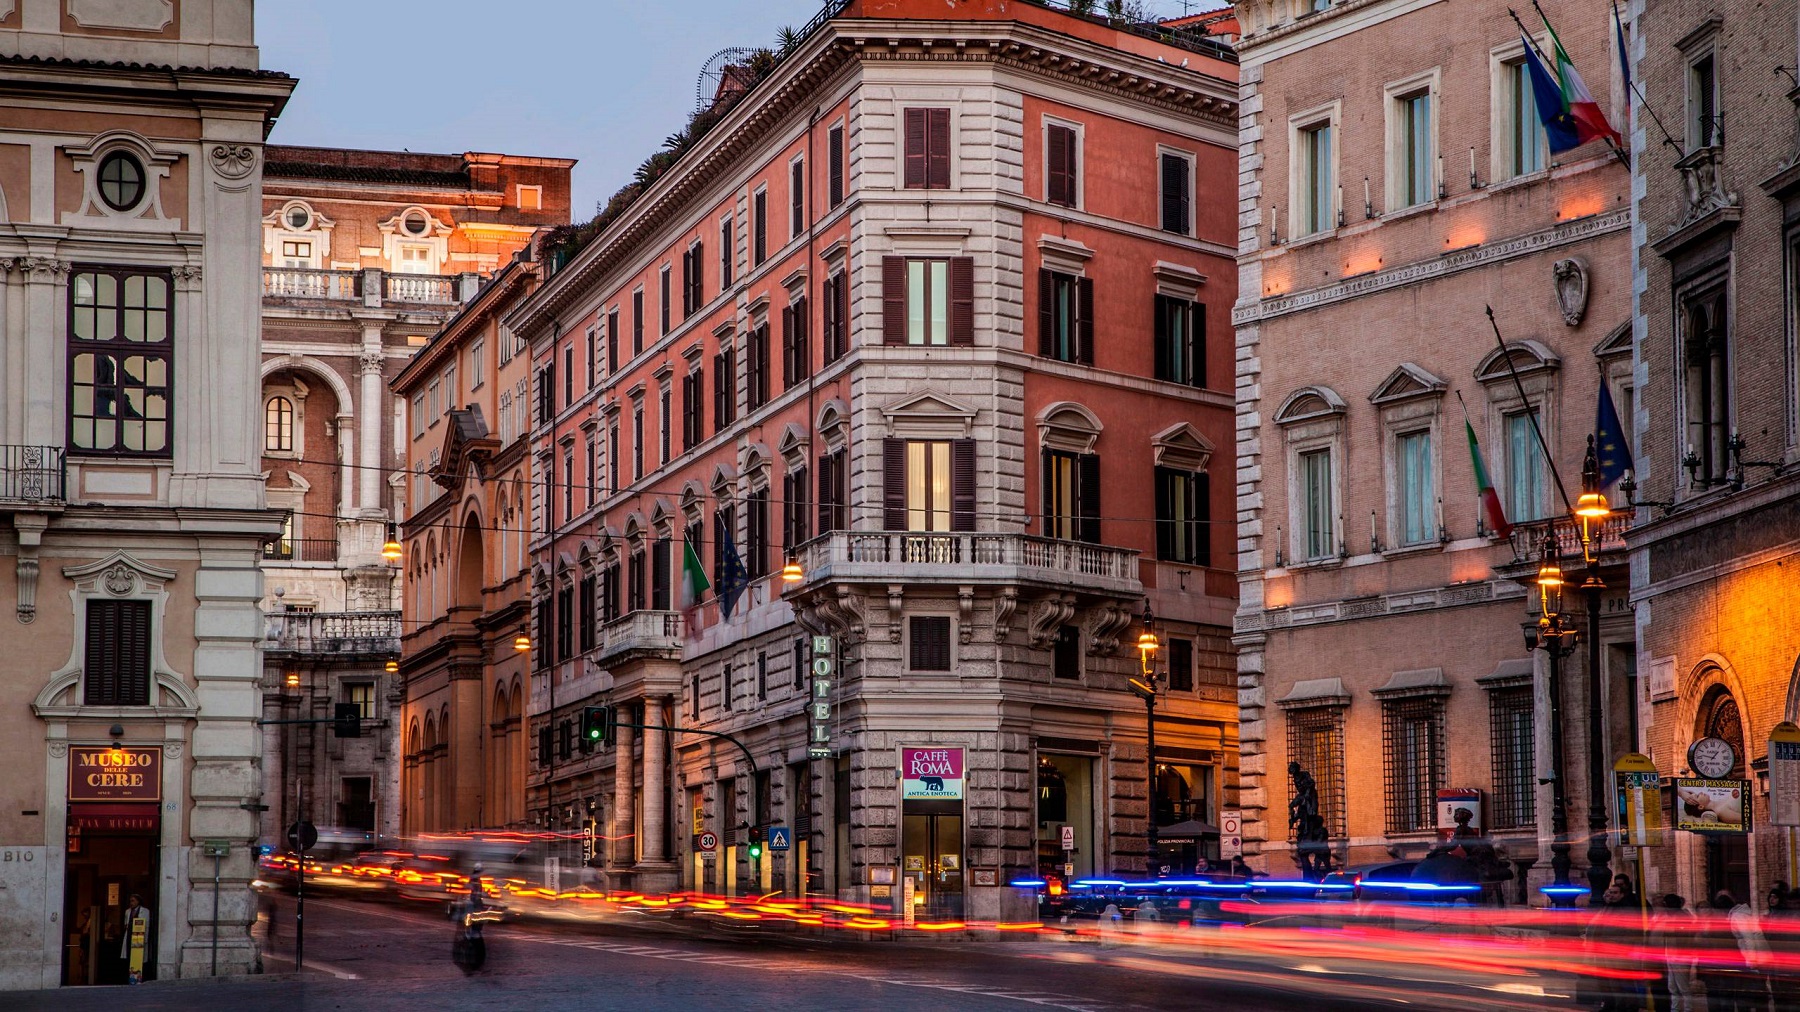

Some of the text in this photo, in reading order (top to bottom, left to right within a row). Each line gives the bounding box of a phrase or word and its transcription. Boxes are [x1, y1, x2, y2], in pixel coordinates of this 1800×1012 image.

[813, 636, 831, 742] HOTEL
[79, 753, 152, 767] MUSEO
[913, 750, 949, 761] CAFFÈ
[911, 760, 955, 775] ROMA
[87, 773, 143, 787] CERE
[1706, 780, 1740, 788] MASSAGGI
[703, 836, 714, 846] 30
